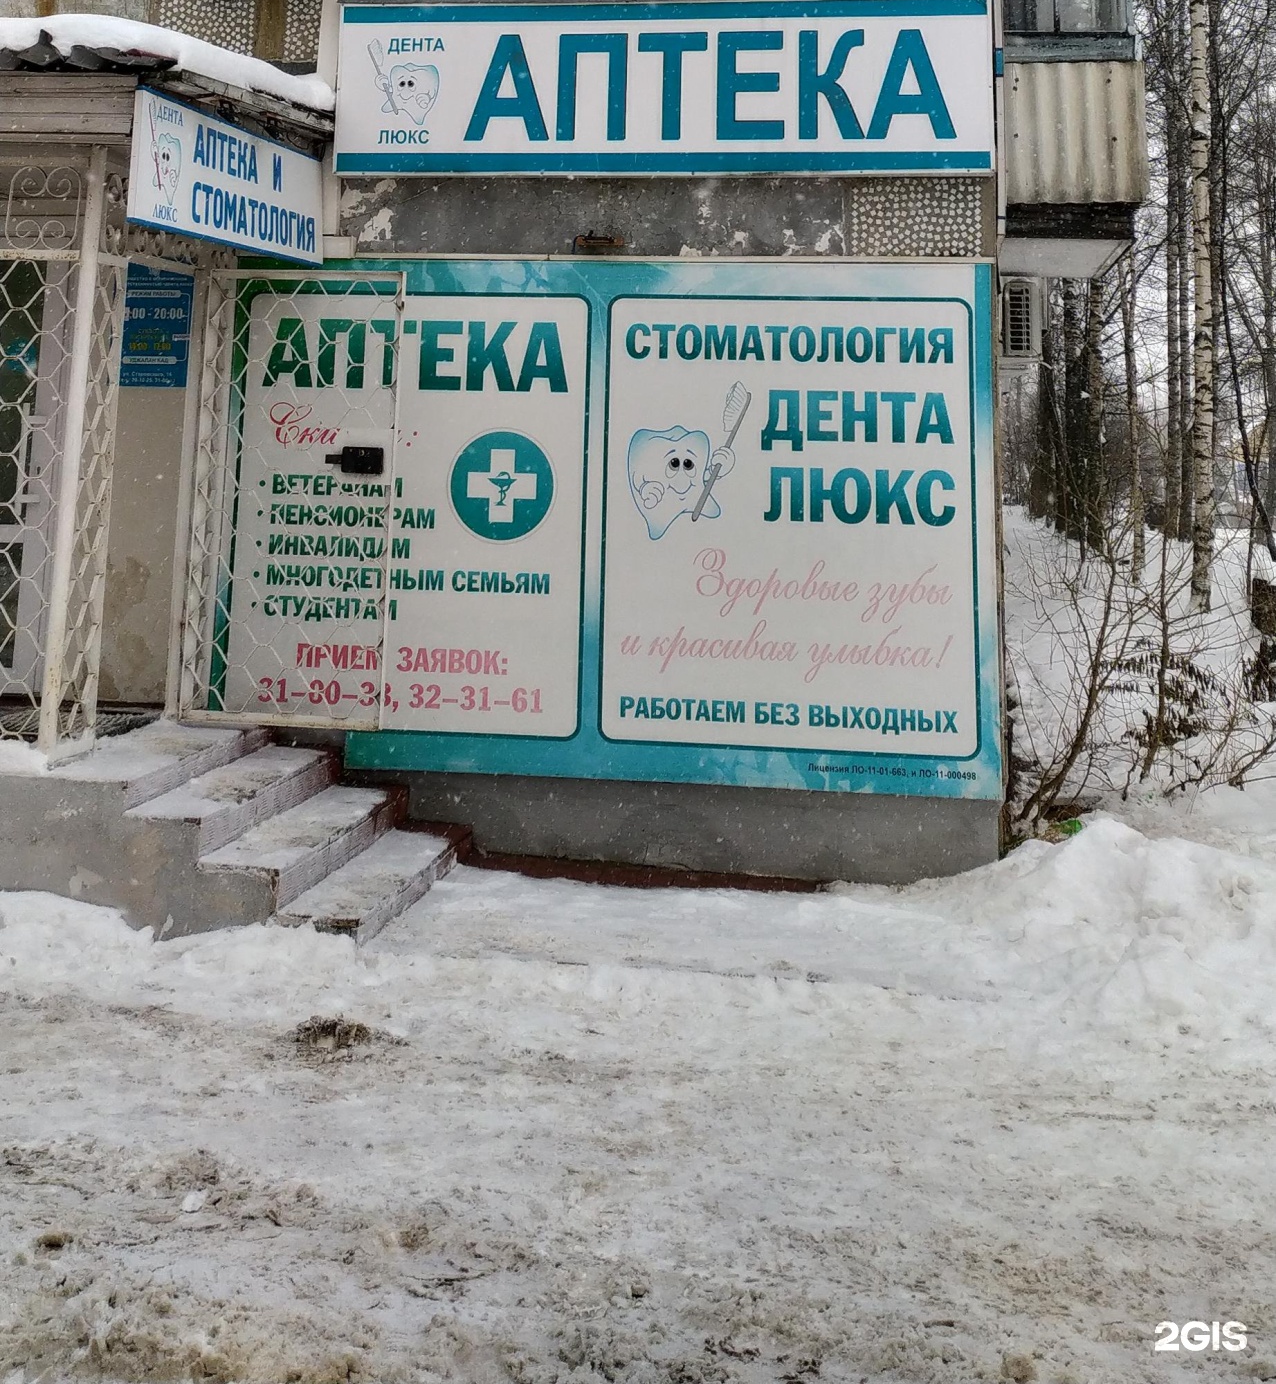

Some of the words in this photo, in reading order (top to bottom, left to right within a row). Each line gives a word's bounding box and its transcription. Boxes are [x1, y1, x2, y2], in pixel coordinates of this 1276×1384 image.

[388, 38, 445, 55] ДЕНТА
[463, 29, 957, 141] АПТЕКА
[156, 103, 184, 127] ДЕНТА
[378, 130, 430, 144] ЛЮКС
[193, 124, 259, 184] АПТЕКА
[272, 153, 282, 193] И
[152, 204, 178, 223] ЛЮКС
[191, 181, 316, 253] СТОМАТОЛОГИЯ
[125, 307, 146, 320] :00
[154, 307, 184, 320] 20:00
[262, 317, 569, 393] АПТЕКА
[625, 323, 954, 364] СТОМАТОЛОГИЯ
[760, 389, 955, 452] ДЕНТА
[763, 466, 957, 527] ЛЮКС
[452, 570, 550, 595] СЕМЬЯМ
[693, 548, 859, 617] Здоровые
[861, 563, 954, 623] зубы
[396, 647, 508, 675] ЗАЯВОК:
[620, 635, 642, 656] и
[648, 619, 799, 673] красивая
[804, 625, 954, 683] улыбка!
[409, 683, 543, 713] 32-31-61
[620, 696, 745, 723] РАБОТАЕМ
[754, 702, 800, 726] БЕЗ
[808, 705, 958, 735] ВЫХОДНЫХ
[808, 763, 850, 774] Лицензия
